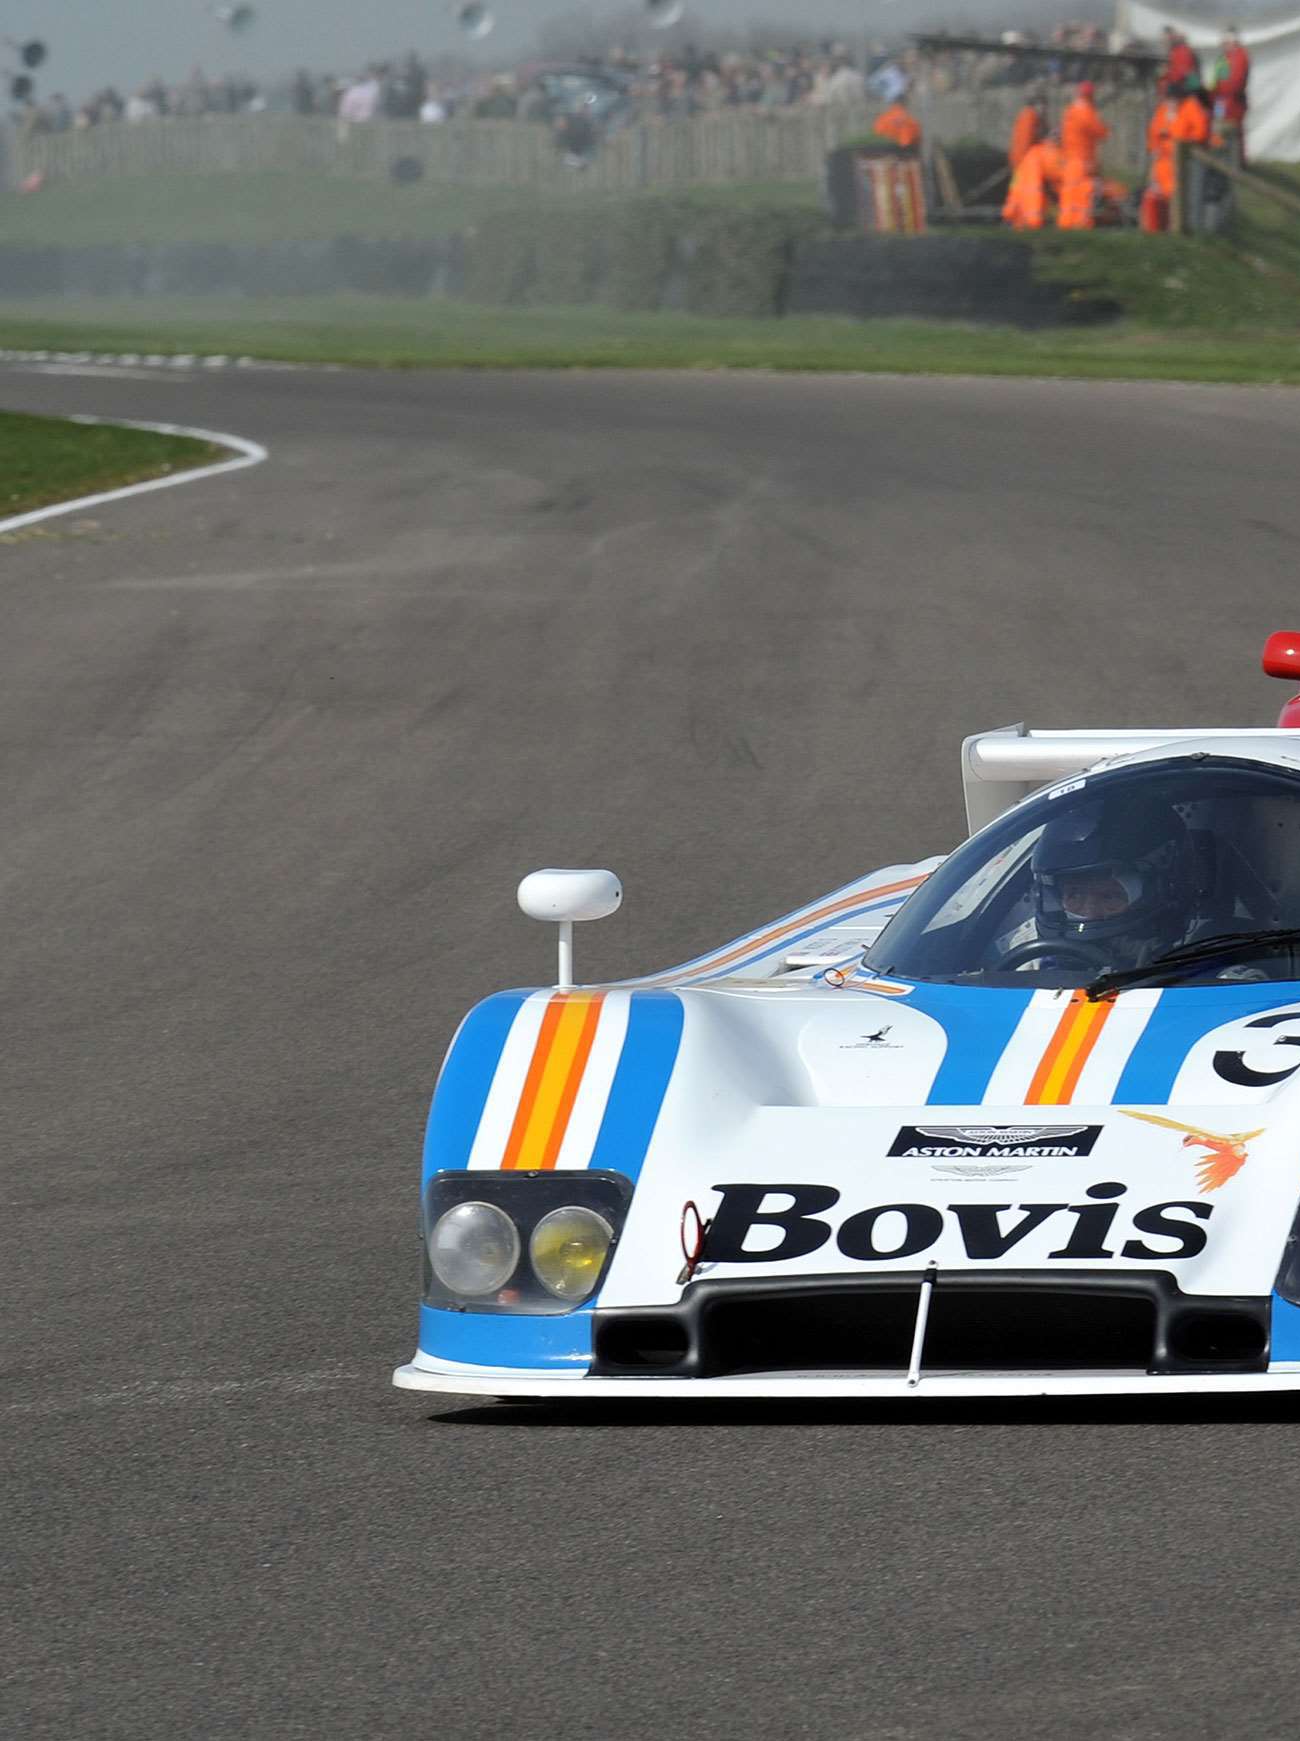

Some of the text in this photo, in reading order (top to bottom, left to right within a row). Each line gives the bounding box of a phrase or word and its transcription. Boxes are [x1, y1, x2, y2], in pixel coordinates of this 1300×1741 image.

[902, 1147, 1078, 1157] ASTON MARTIN
[702, 1181, 1214, 1263] Bovis
